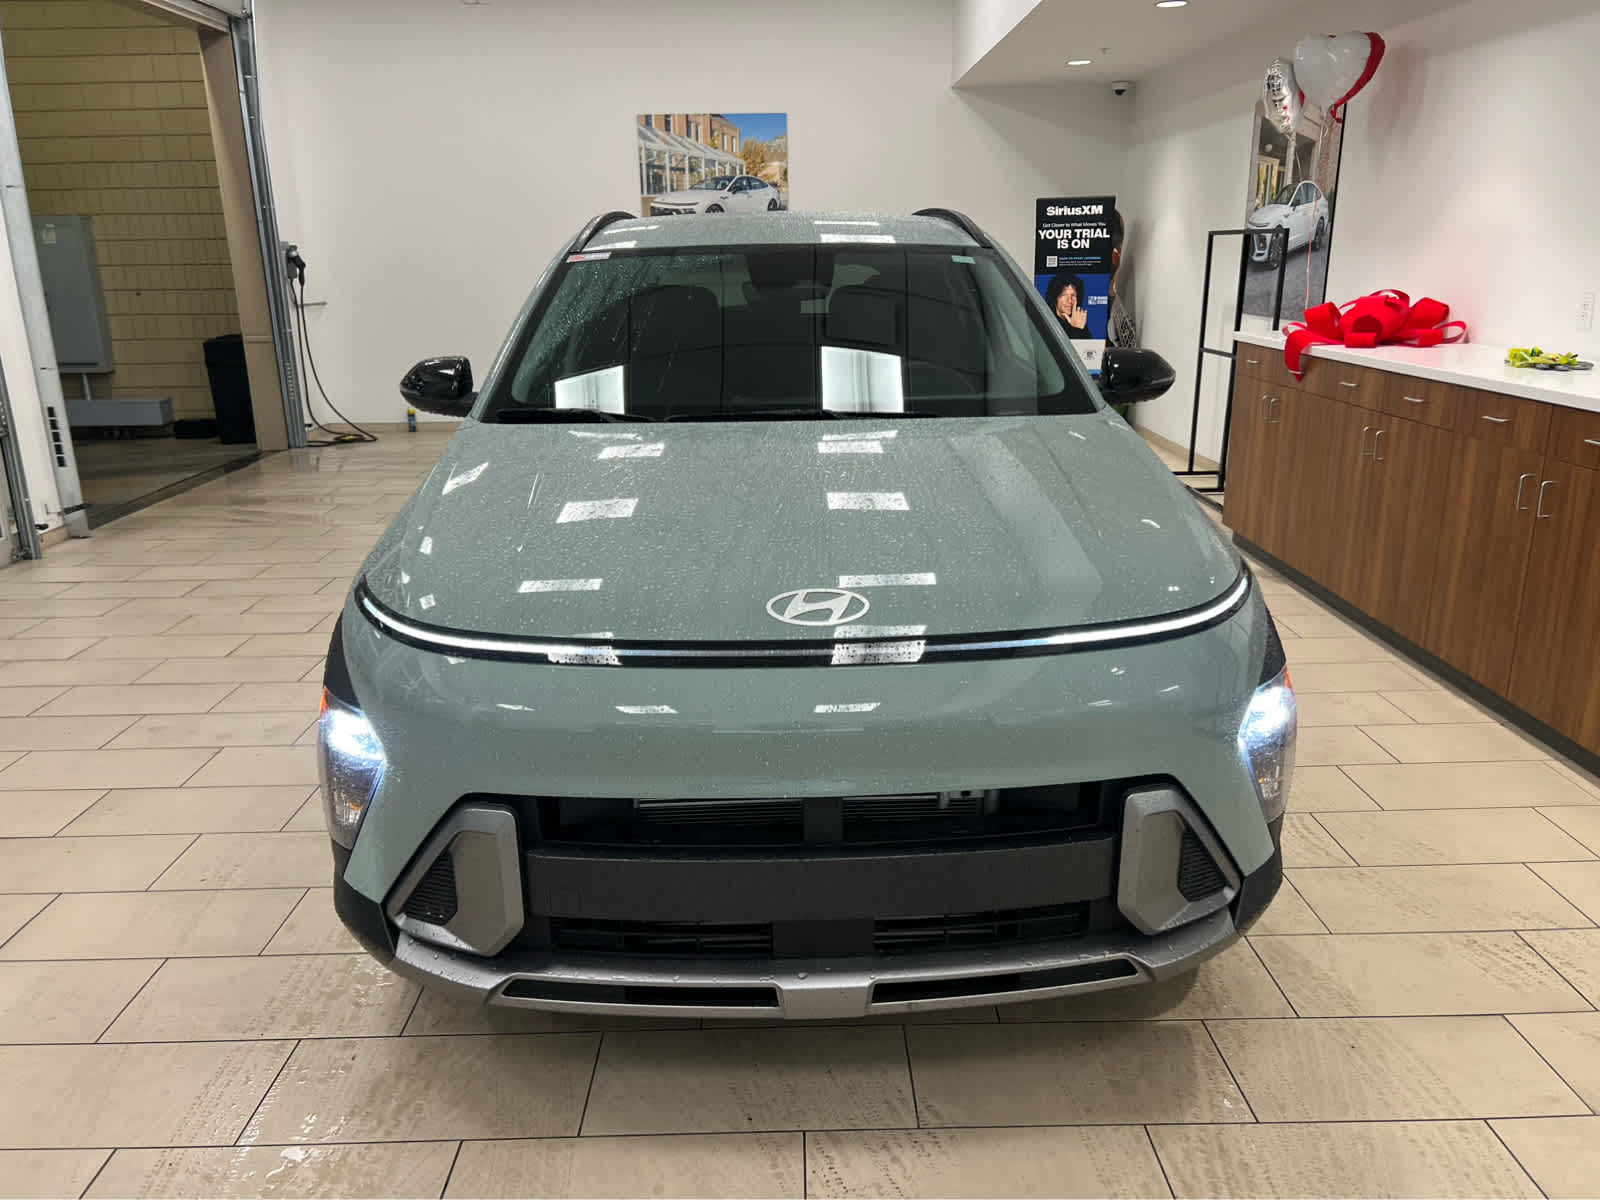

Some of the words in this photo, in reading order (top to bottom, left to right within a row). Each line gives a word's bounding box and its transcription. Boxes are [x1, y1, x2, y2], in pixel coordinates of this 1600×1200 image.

[1046, 205, 1103, 216] SiriusXM
[1038, 229, 1072, 240] YOUR
[1074, 228, 1110, 239] TRIAL
[1057, 239, 1069, 249] IS
[1071, 239, 1090, 249] ON
